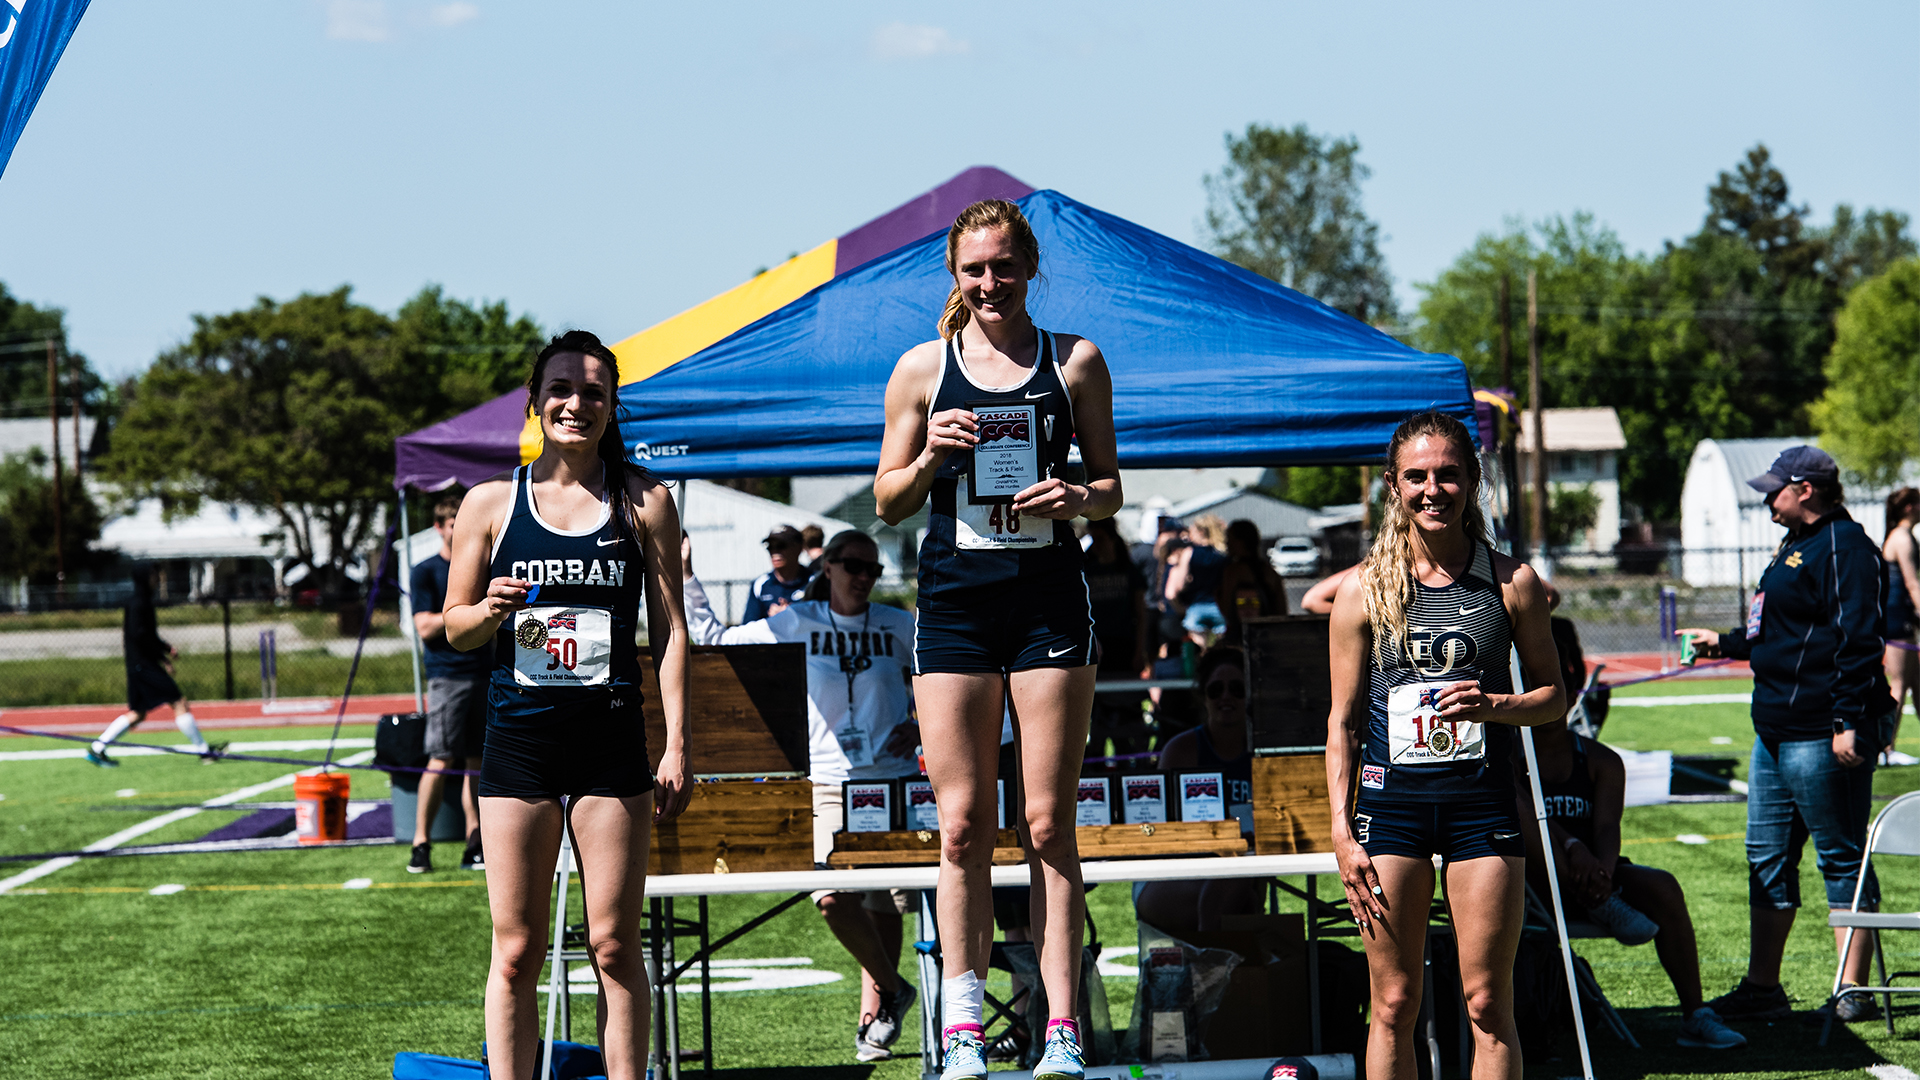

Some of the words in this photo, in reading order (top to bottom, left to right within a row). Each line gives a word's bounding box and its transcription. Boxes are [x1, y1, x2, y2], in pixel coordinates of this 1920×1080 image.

[979, 412, 1028, 420] CASCADE
[981, 423, 1028, 439] CCC
[634, 442, 689, 461] QUEST
[989, 503, 1020, 534] 48
[511, 559, 626, 587] CORBAN
[548, 618, 576, 629] CCC
[811, 631, 894, 657] EASTERN
[546, 638, 577, 671] 50
[564, 673, 594, 681] Championships
[1364, 772, 1382, 782] CCC
[1128, 786, 1160, 798] CCC
[1186, 784, 1219, 796] CCC
[852, 795, 884, 807] CCC
